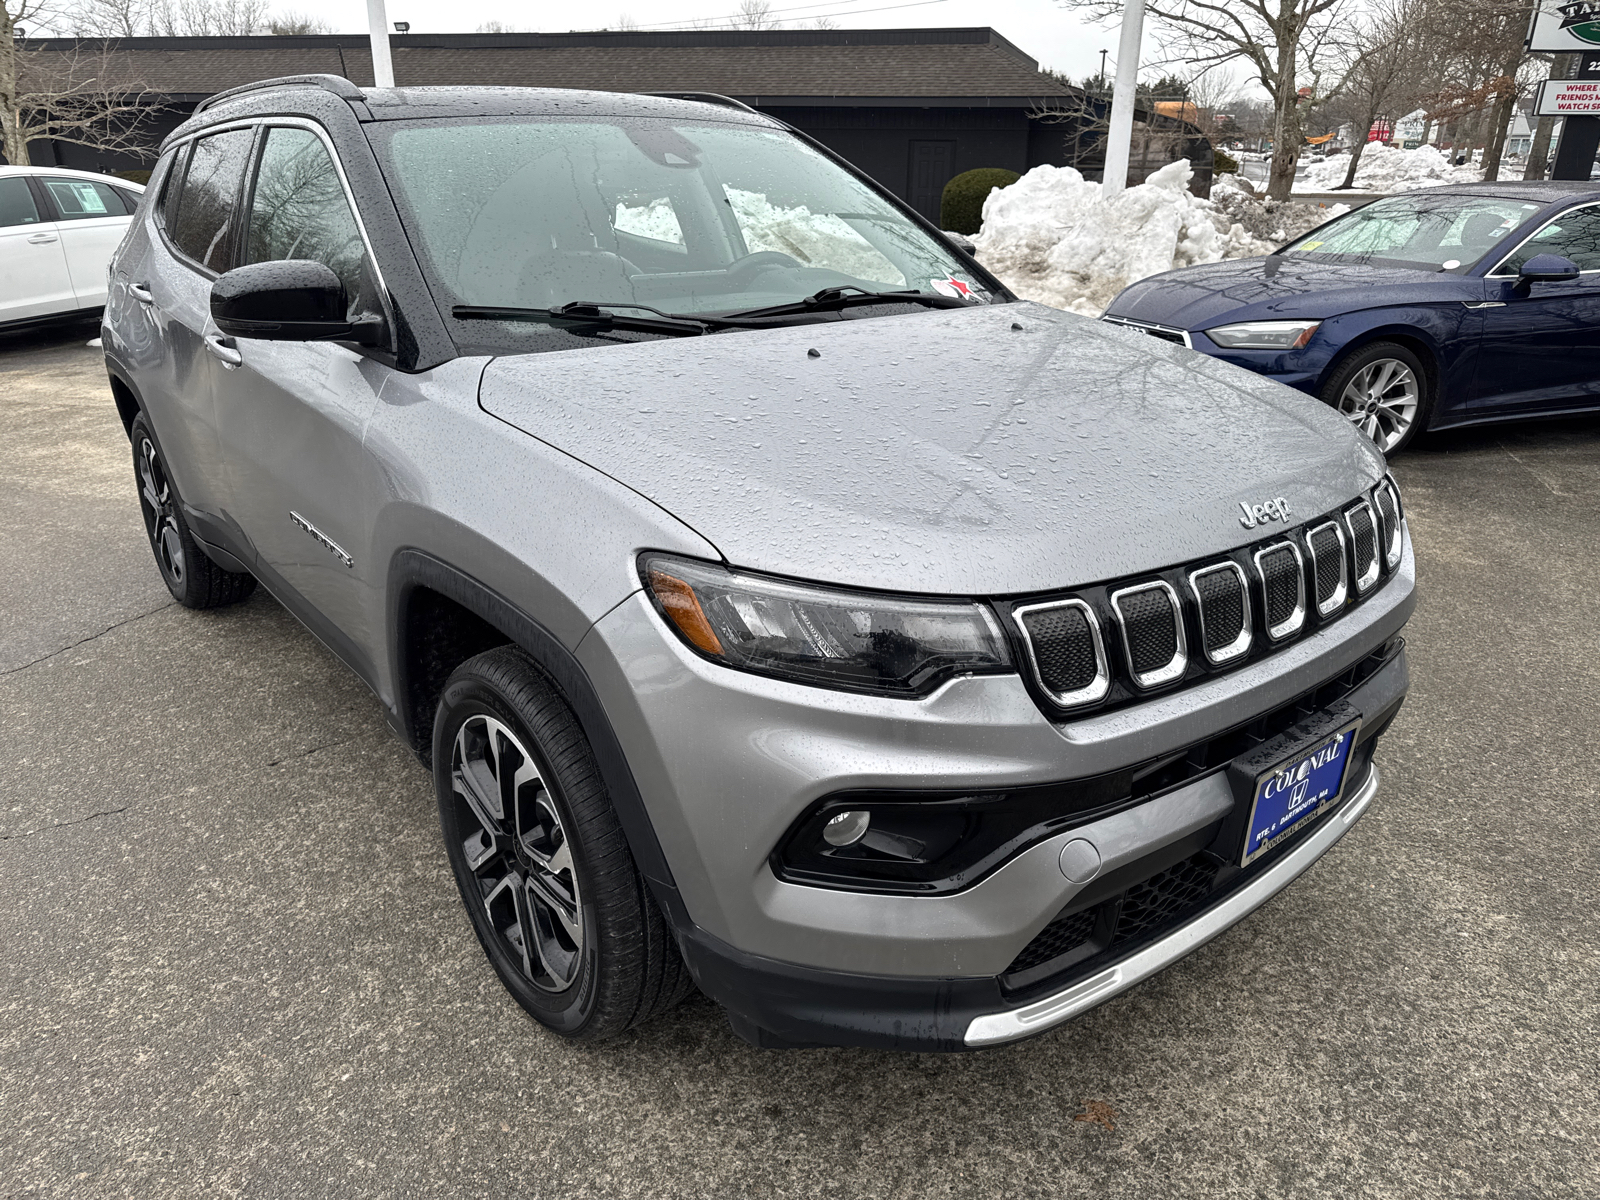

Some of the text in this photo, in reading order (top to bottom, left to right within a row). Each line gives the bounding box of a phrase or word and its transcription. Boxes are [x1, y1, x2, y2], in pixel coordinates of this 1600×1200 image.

[1239, 497, 1291, 530] Jeep
[1264, 743, 1340, 799] COLONIAL
[1271, 822, 1277, 831] 6
[1319, 788, 1329, 799] MA
[1266, 826, 1296, 850] COLONIAL
